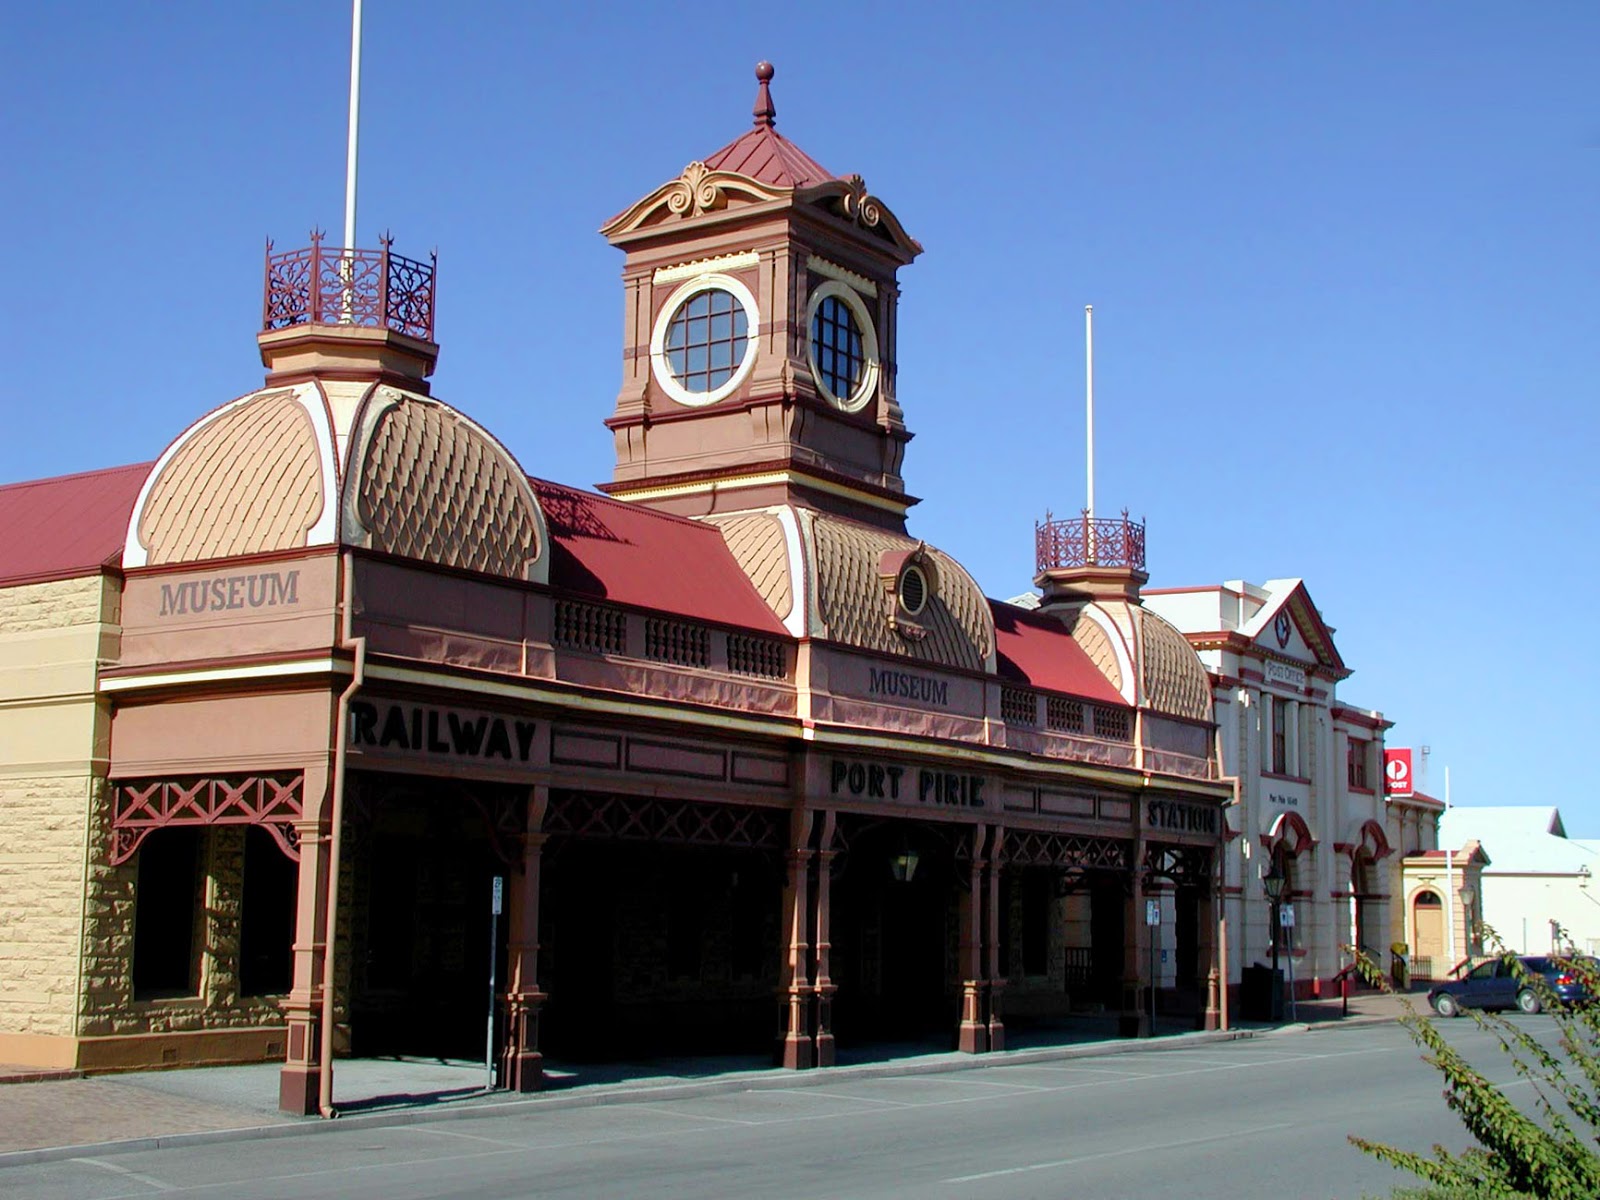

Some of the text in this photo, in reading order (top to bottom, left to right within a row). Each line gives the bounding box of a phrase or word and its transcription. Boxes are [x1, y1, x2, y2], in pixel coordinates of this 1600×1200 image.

[159, 570, 300, 616] MUSEUM
[869, 667, 948, 706] MUSEUM
[351, 701, 536, 761] RAILWAY
[831, 760, 985, 807] PORT PIRIE
[1148, 800, 1216, 833] STATION
